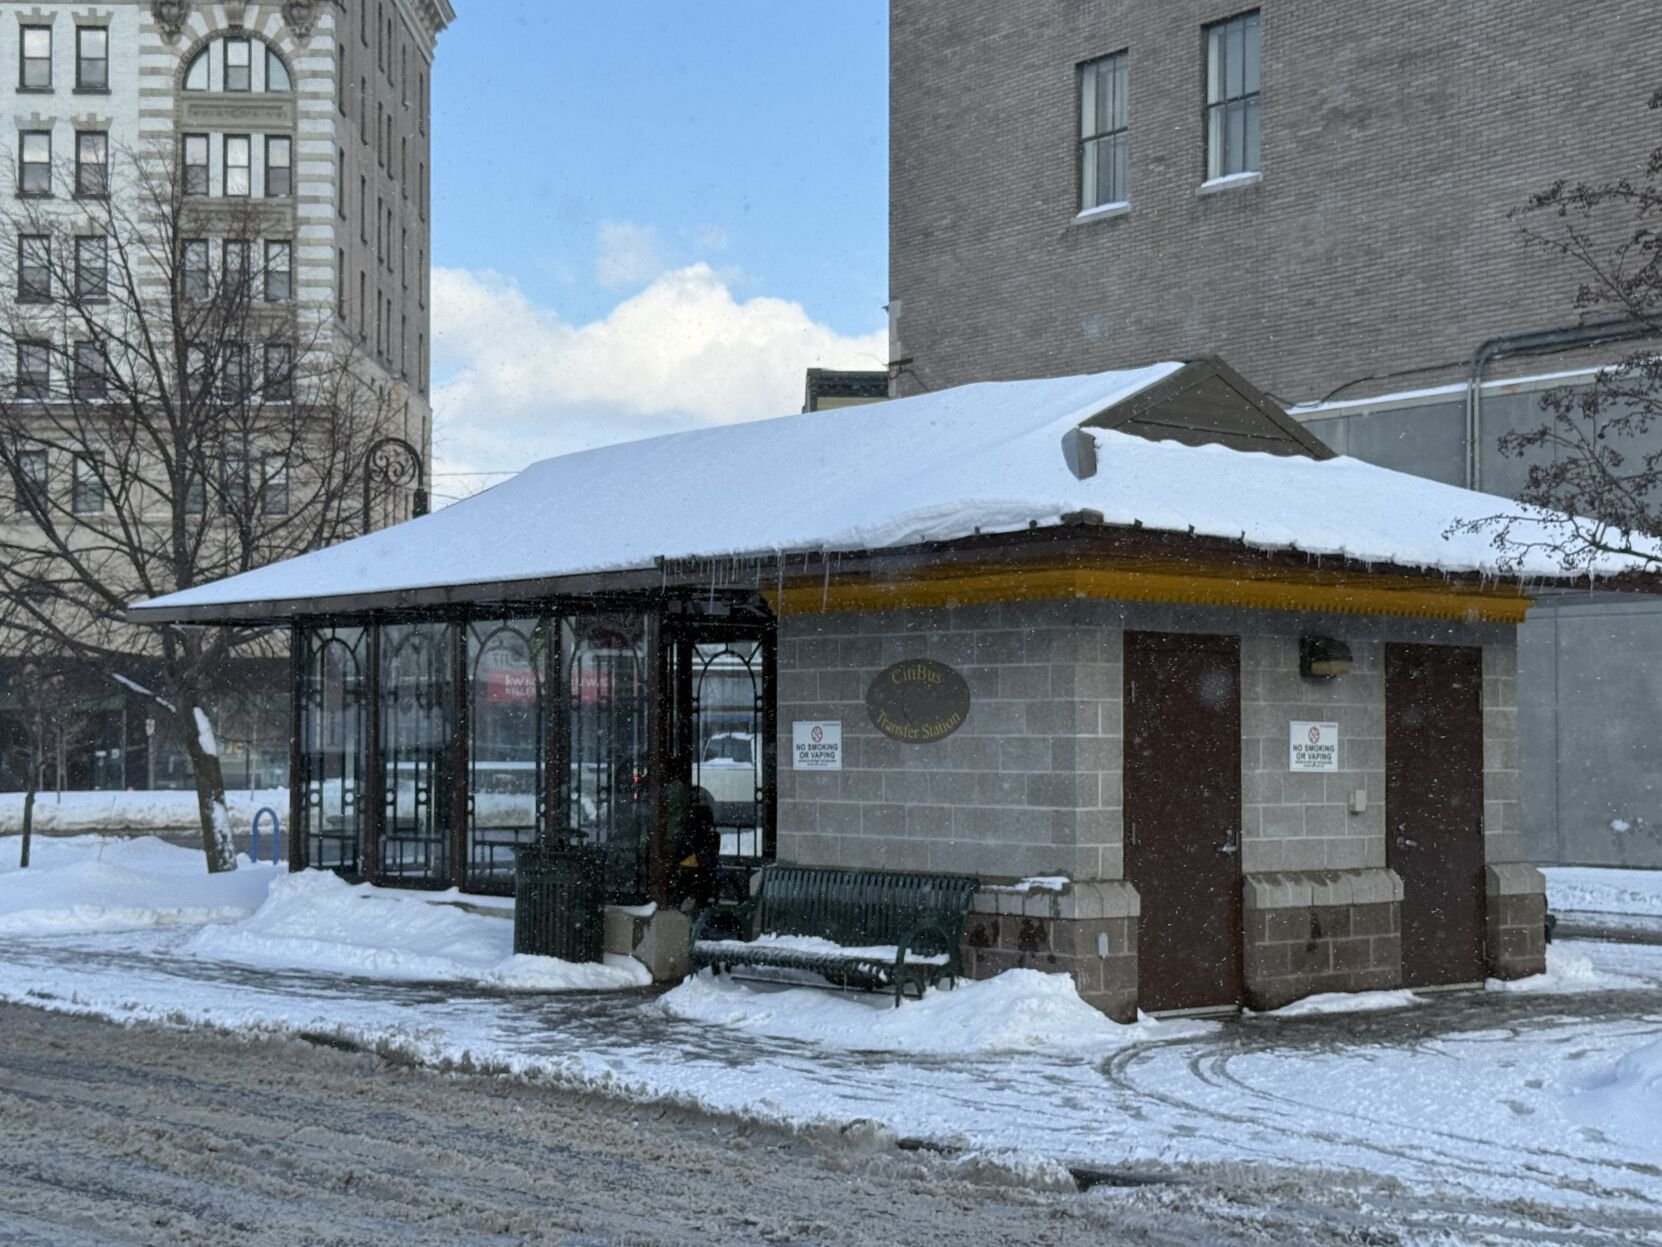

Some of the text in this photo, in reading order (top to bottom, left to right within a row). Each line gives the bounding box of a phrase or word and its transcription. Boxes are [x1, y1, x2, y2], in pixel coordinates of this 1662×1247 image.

[891, 664, 941, 684] CitiBus
[877, 711, 961, 739] Transfer Station
[796, 743, 838, 751] NO SMOKING
[1293, 744, 1335, 752] NO SMOKING
[799, 751, 835, 759] OR VAPING
[1296, 752, 1332, 760] OR VAPING
